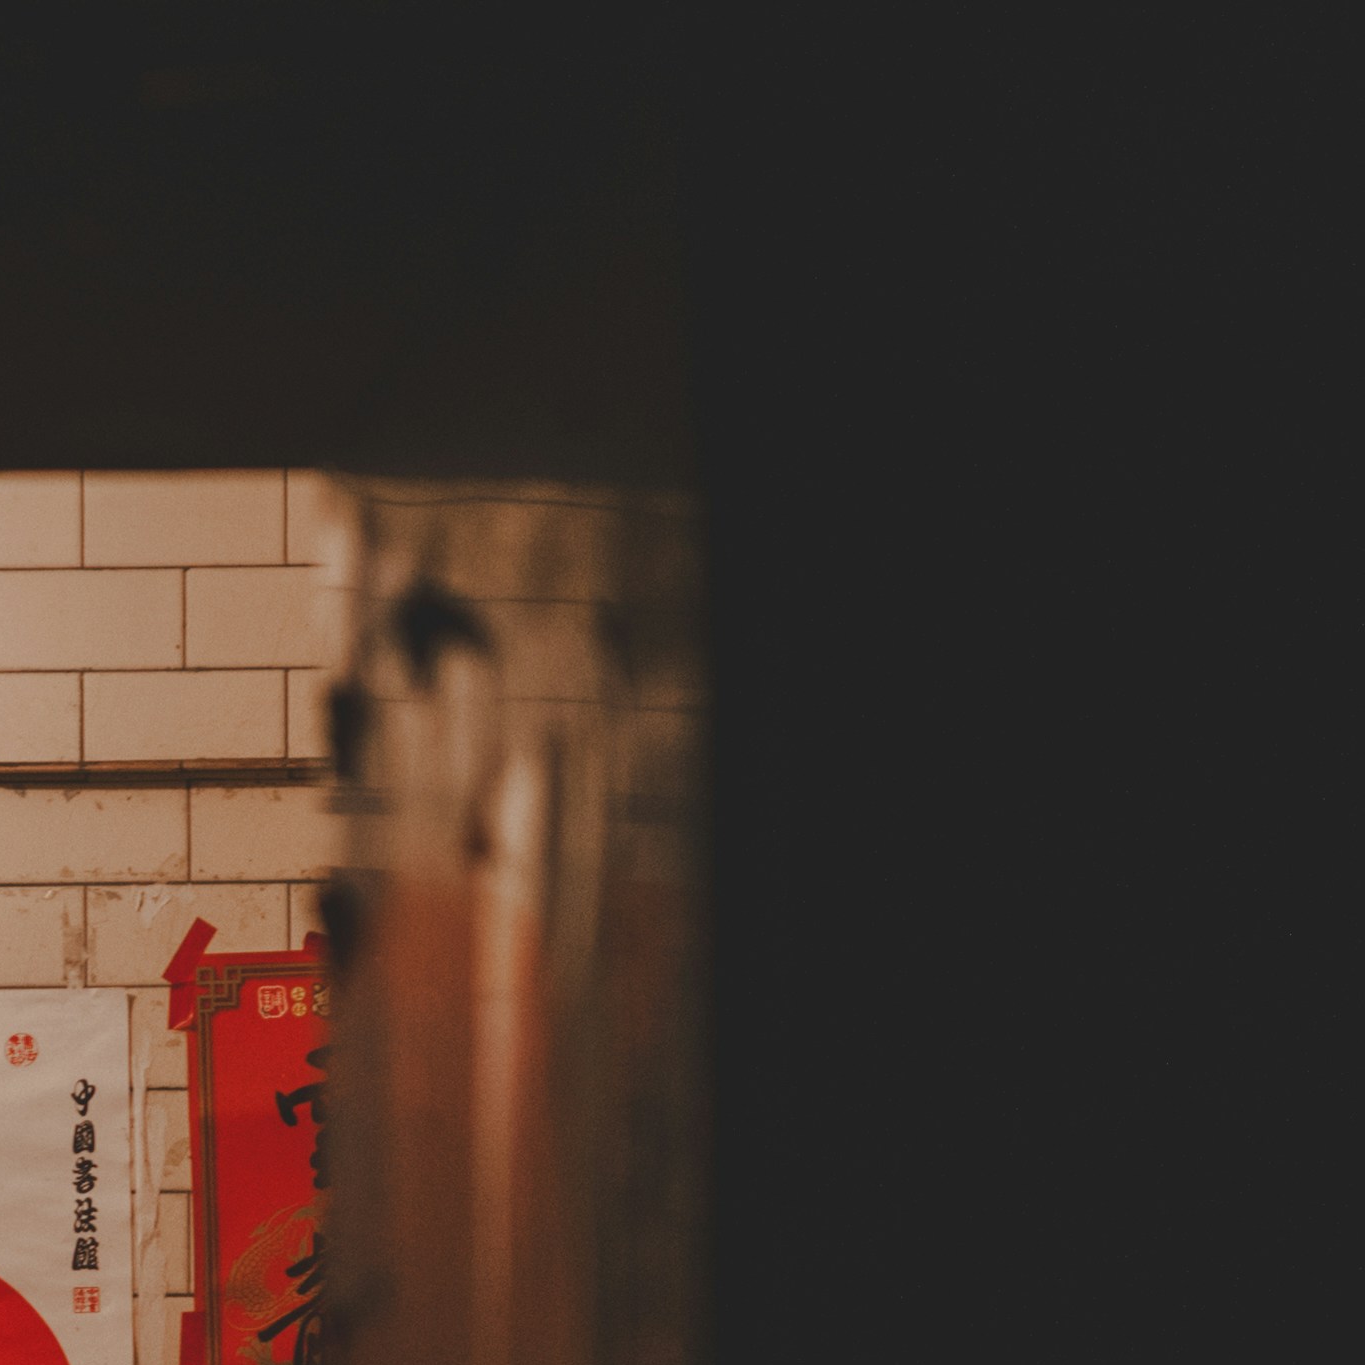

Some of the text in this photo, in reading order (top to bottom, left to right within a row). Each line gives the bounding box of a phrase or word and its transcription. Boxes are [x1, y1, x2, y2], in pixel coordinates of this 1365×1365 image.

[71, 1079, 100, 1271] 中國書法館
